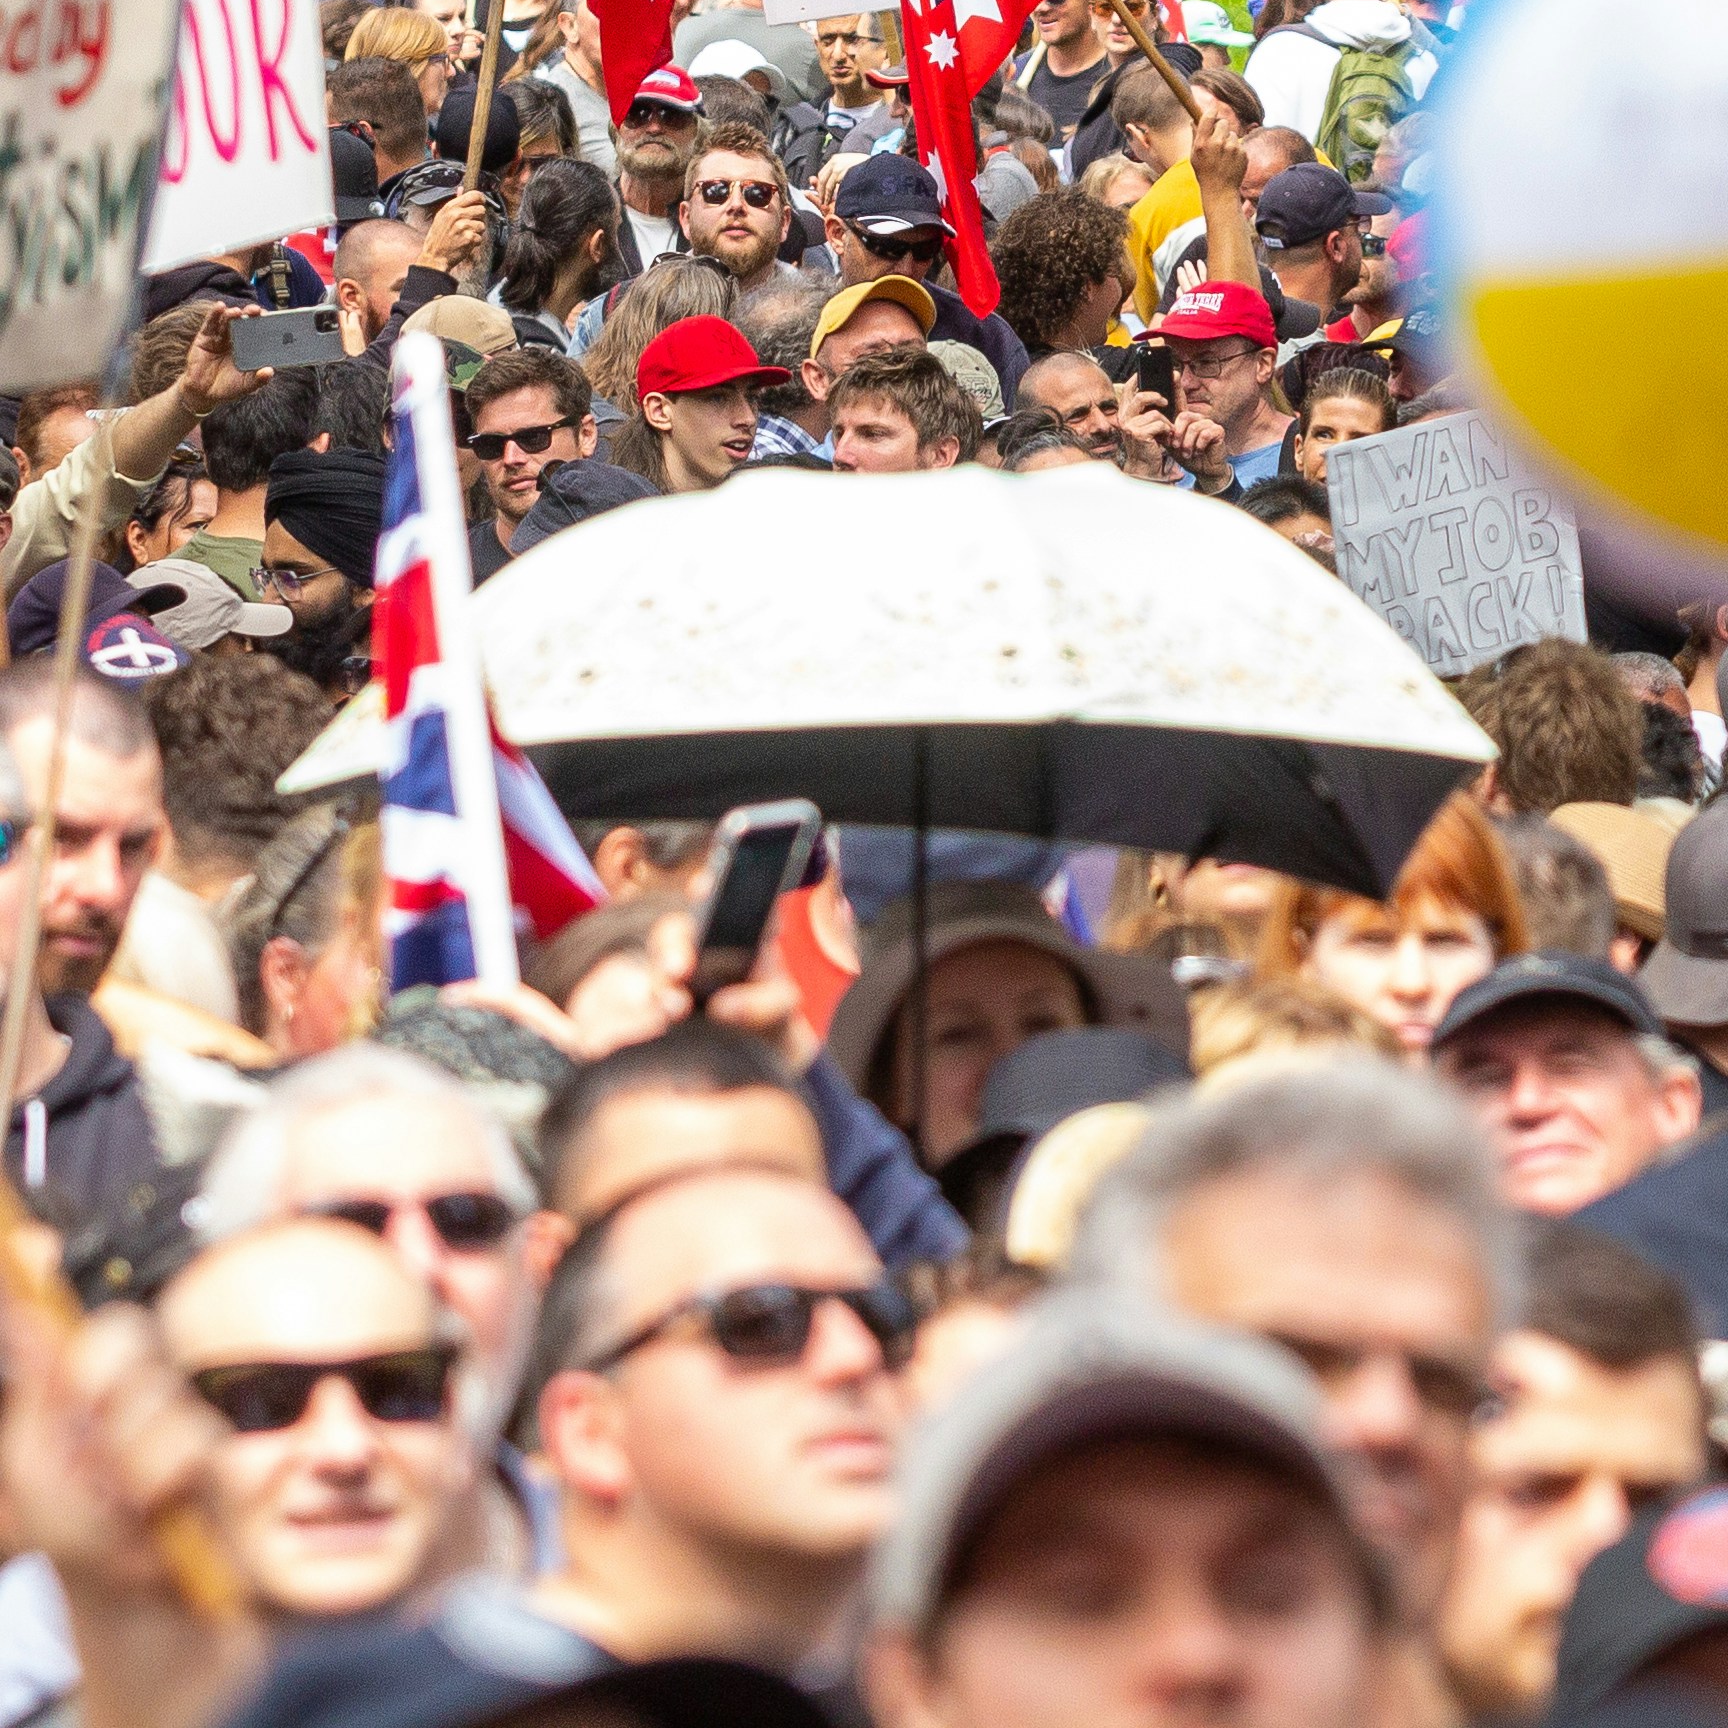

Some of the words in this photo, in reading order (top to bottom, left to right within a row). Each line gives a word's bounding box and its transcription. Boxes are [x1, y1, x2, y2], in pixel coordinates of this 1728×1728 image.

[1334, 451, 1360, 527] I
[1364, 418, 1510, 513] WAN
[1344, 516, 1425, 605] MY
[1428, 487, 1560, 586] JOB
